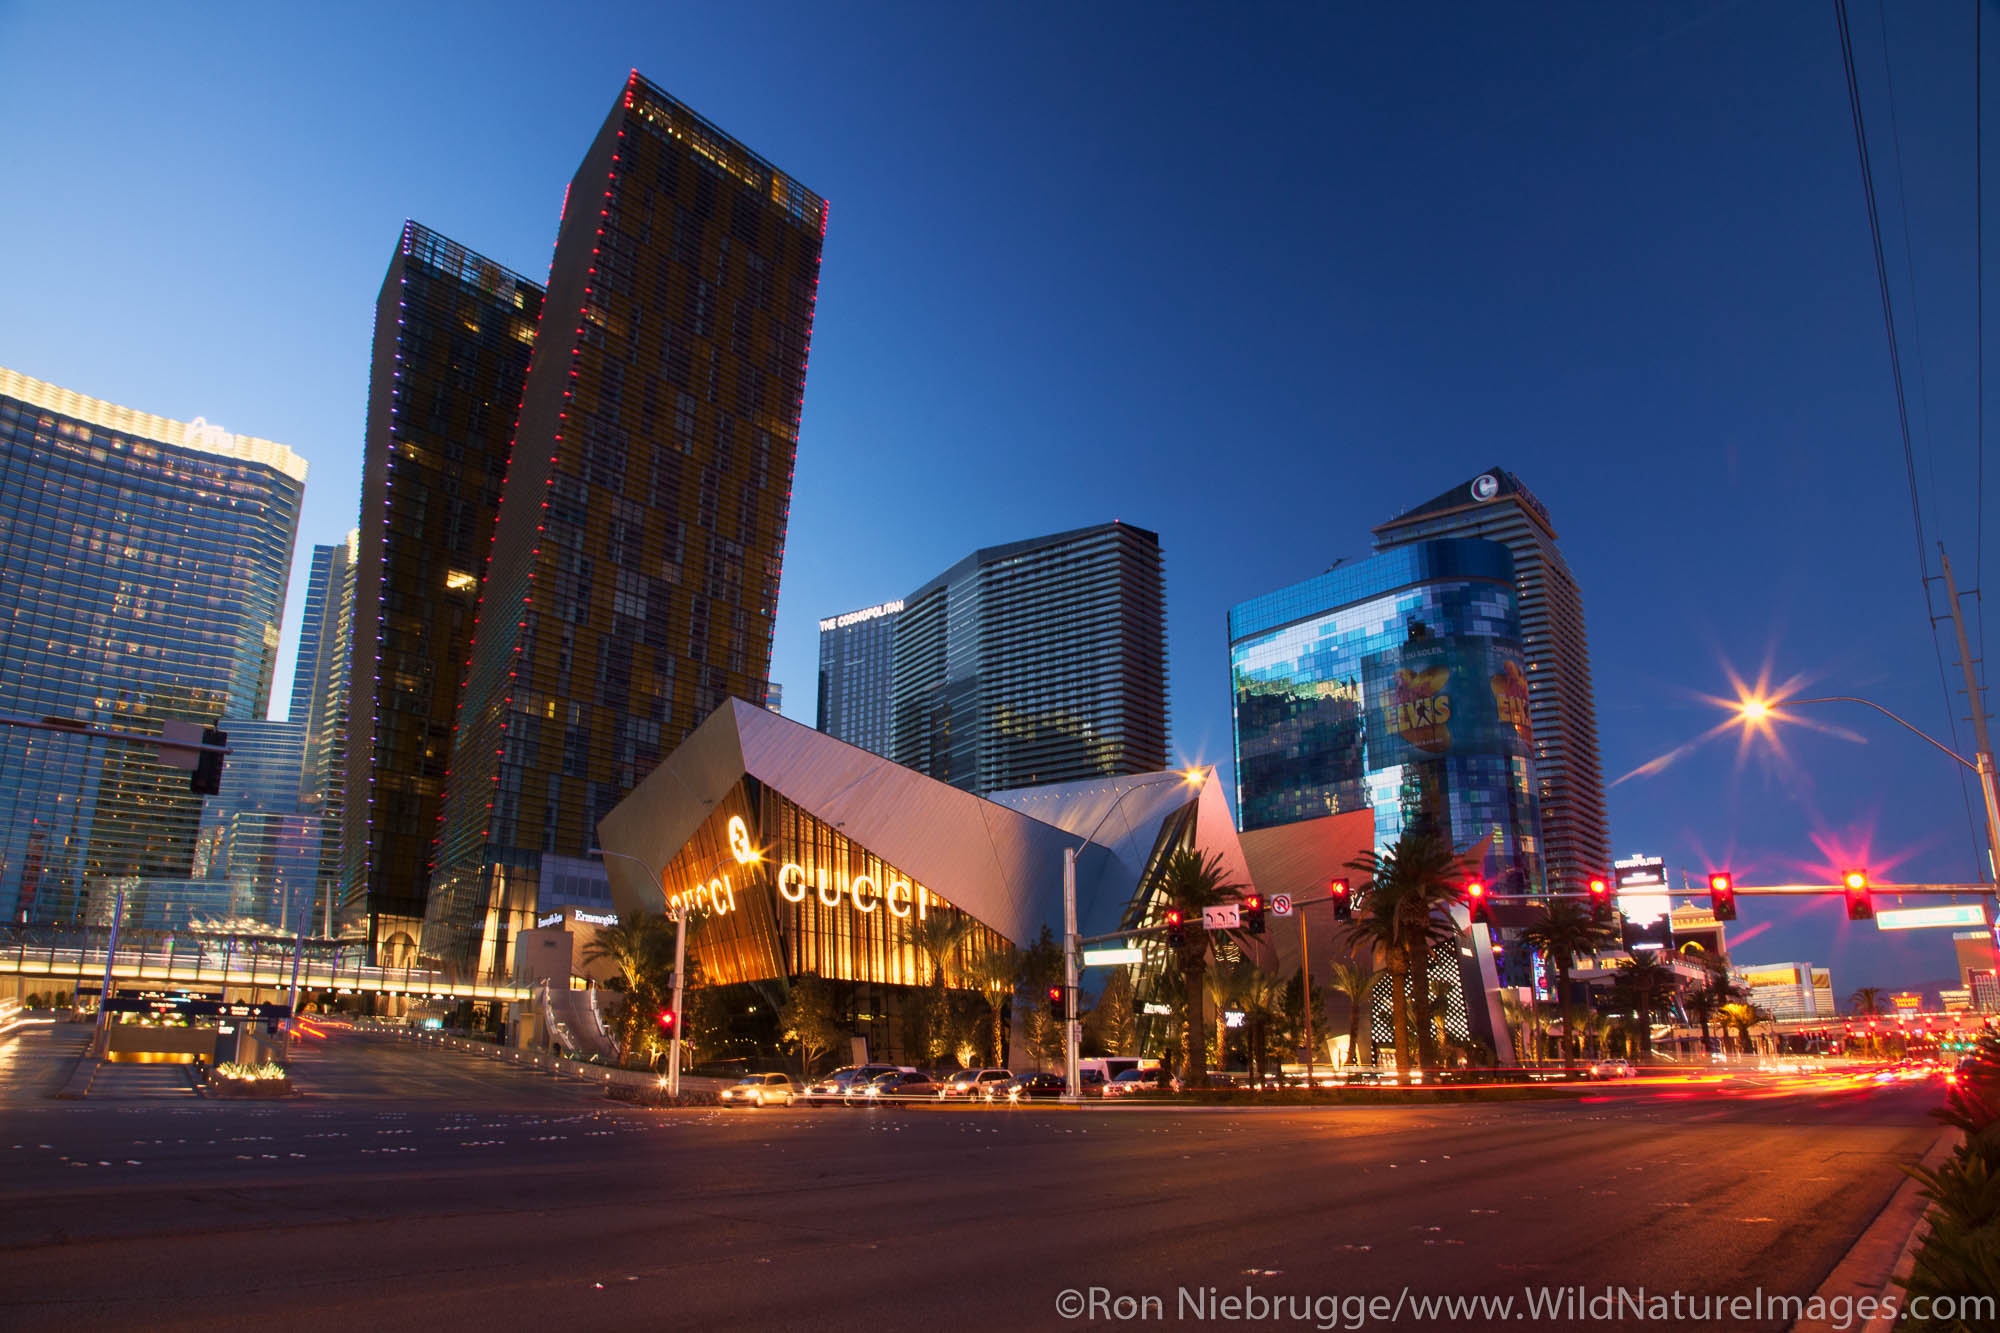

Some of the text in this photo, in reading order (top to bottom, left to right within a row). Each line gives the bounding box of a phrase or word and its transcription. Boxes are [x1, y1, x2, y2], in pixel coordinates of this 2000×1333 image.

[820, 600, 904, 632] THE COSMOPOLITAN
[1384, 696, 1451, 735] ELVIS
[778, 863, 927, 920] GUCCI
